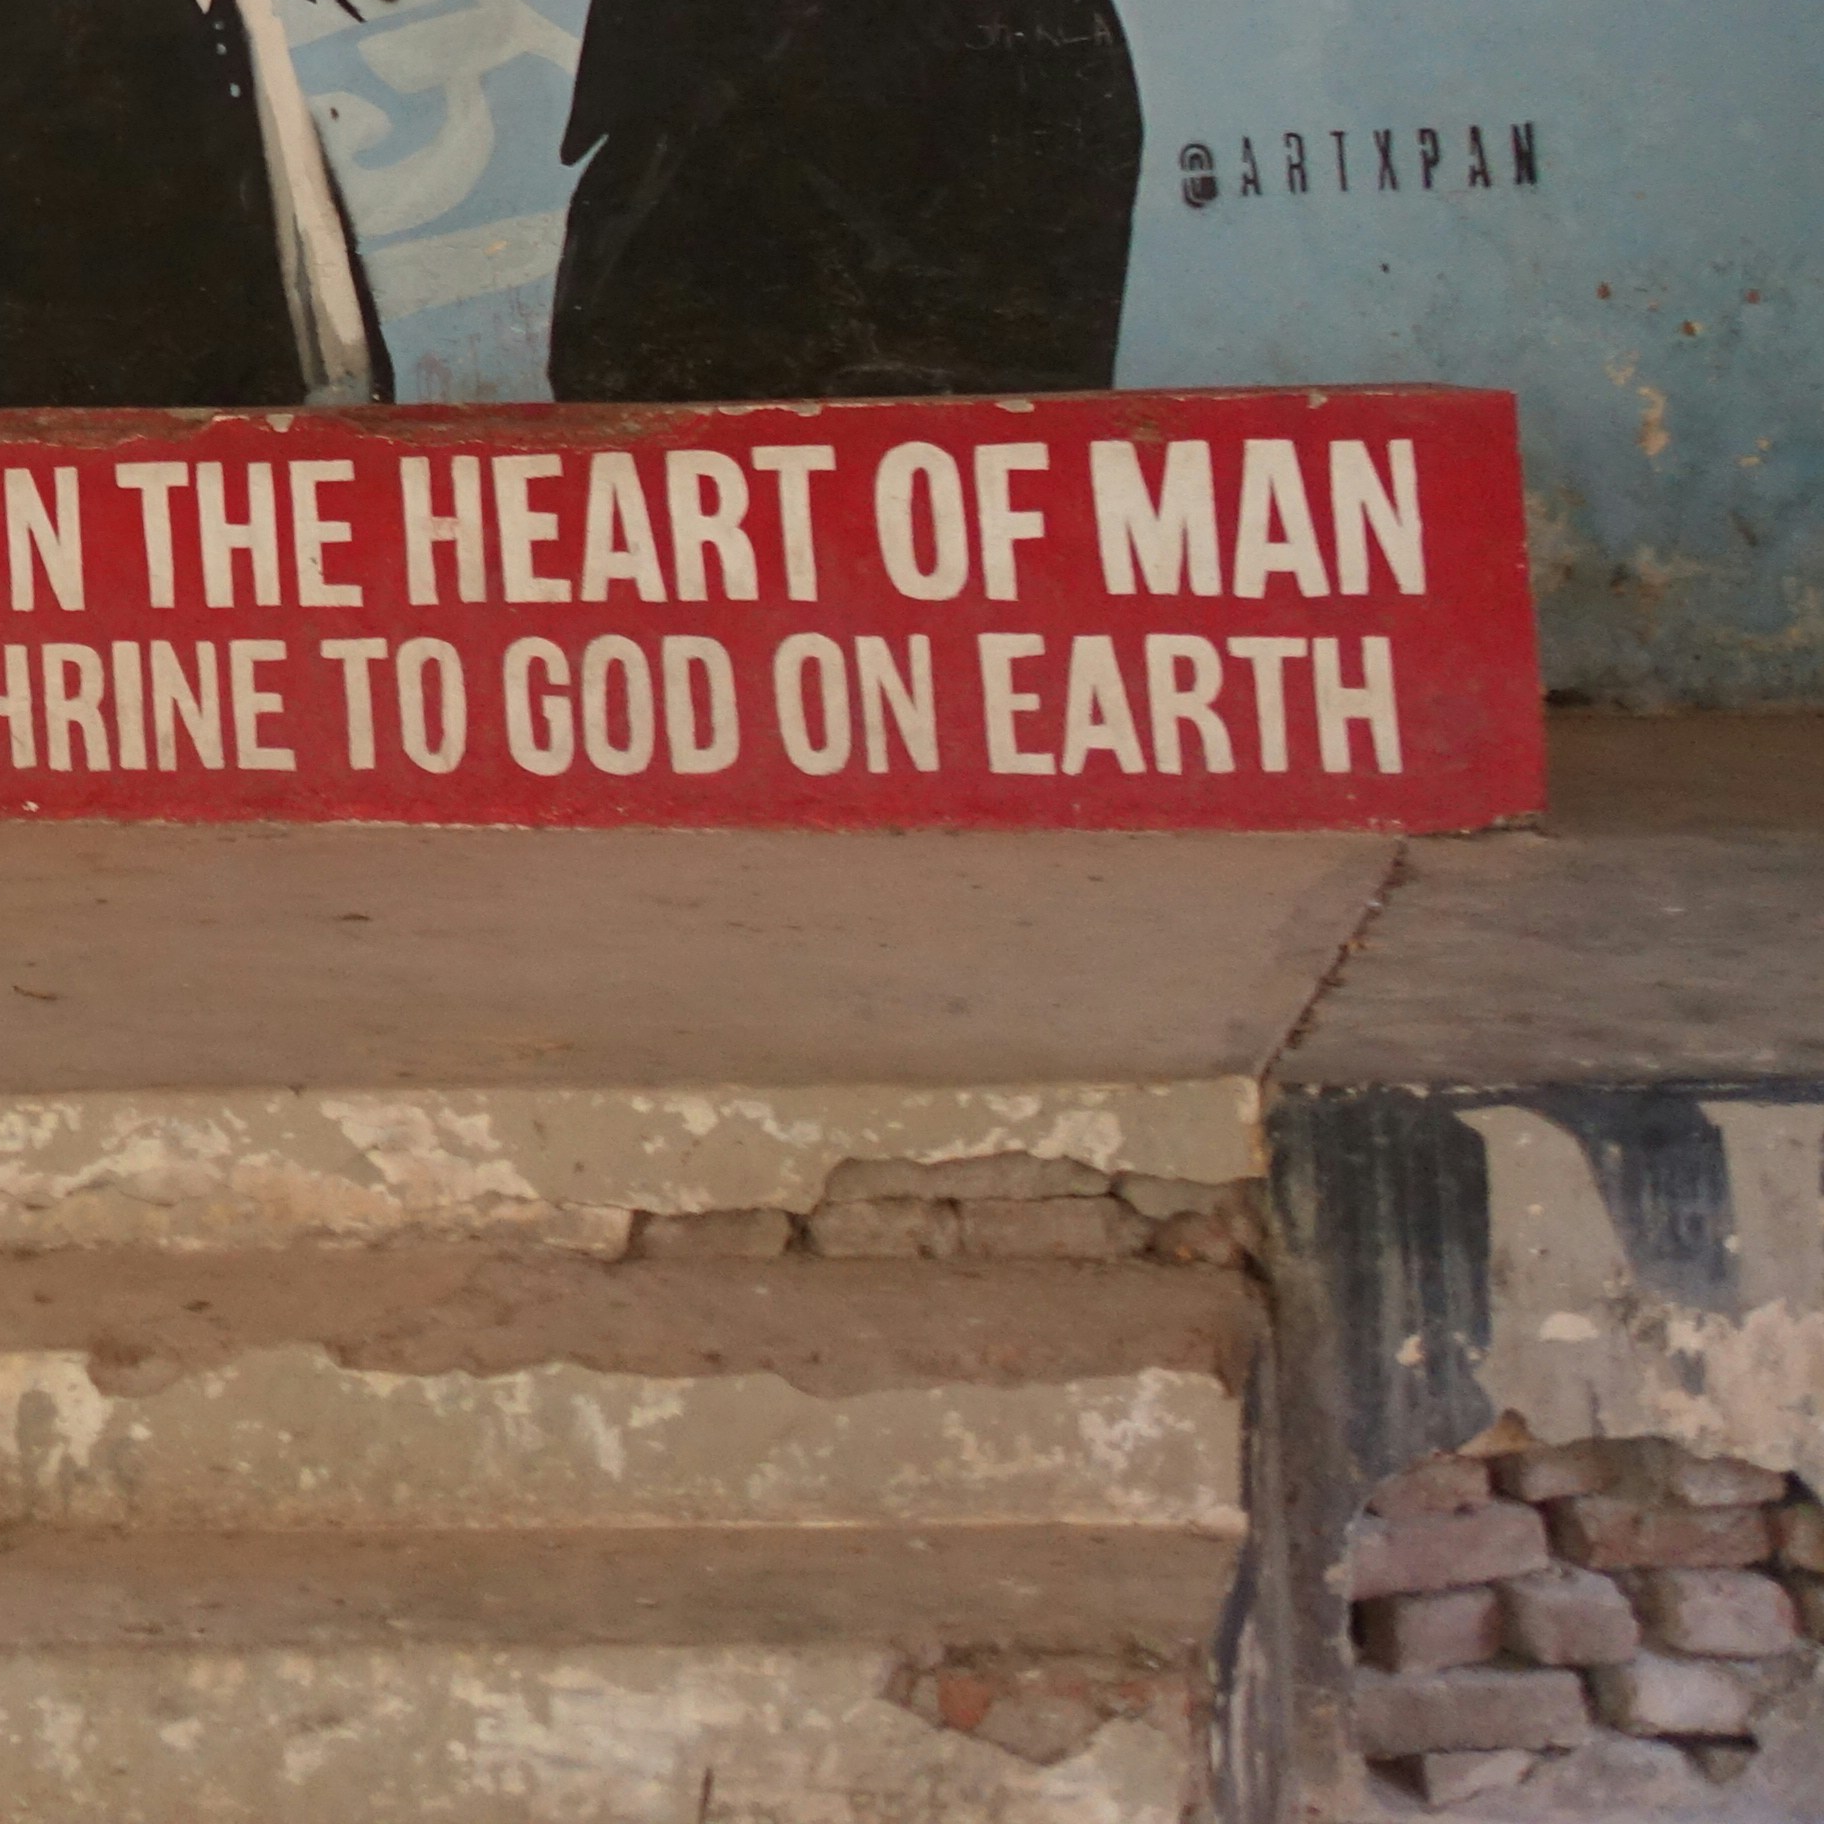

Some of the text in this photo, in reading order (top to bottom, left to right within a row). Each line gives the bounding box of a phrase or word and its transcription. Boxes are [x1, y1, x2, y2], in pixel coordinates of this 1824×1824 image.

[1178, 120, 1540, 211] @ARTXPAN
[115, 459, 364, 608] THE
[400, 445, 836, 606] HEART
[875, 441, 1049, 601] OF
[1090, 438, 1427, 599] MAN
[320, 637, 467, 774] TO
[503, 634, 740, 776] GOD
[773, 632, 939, 776] ON
[977, 632, 1402, 776] EARTH
